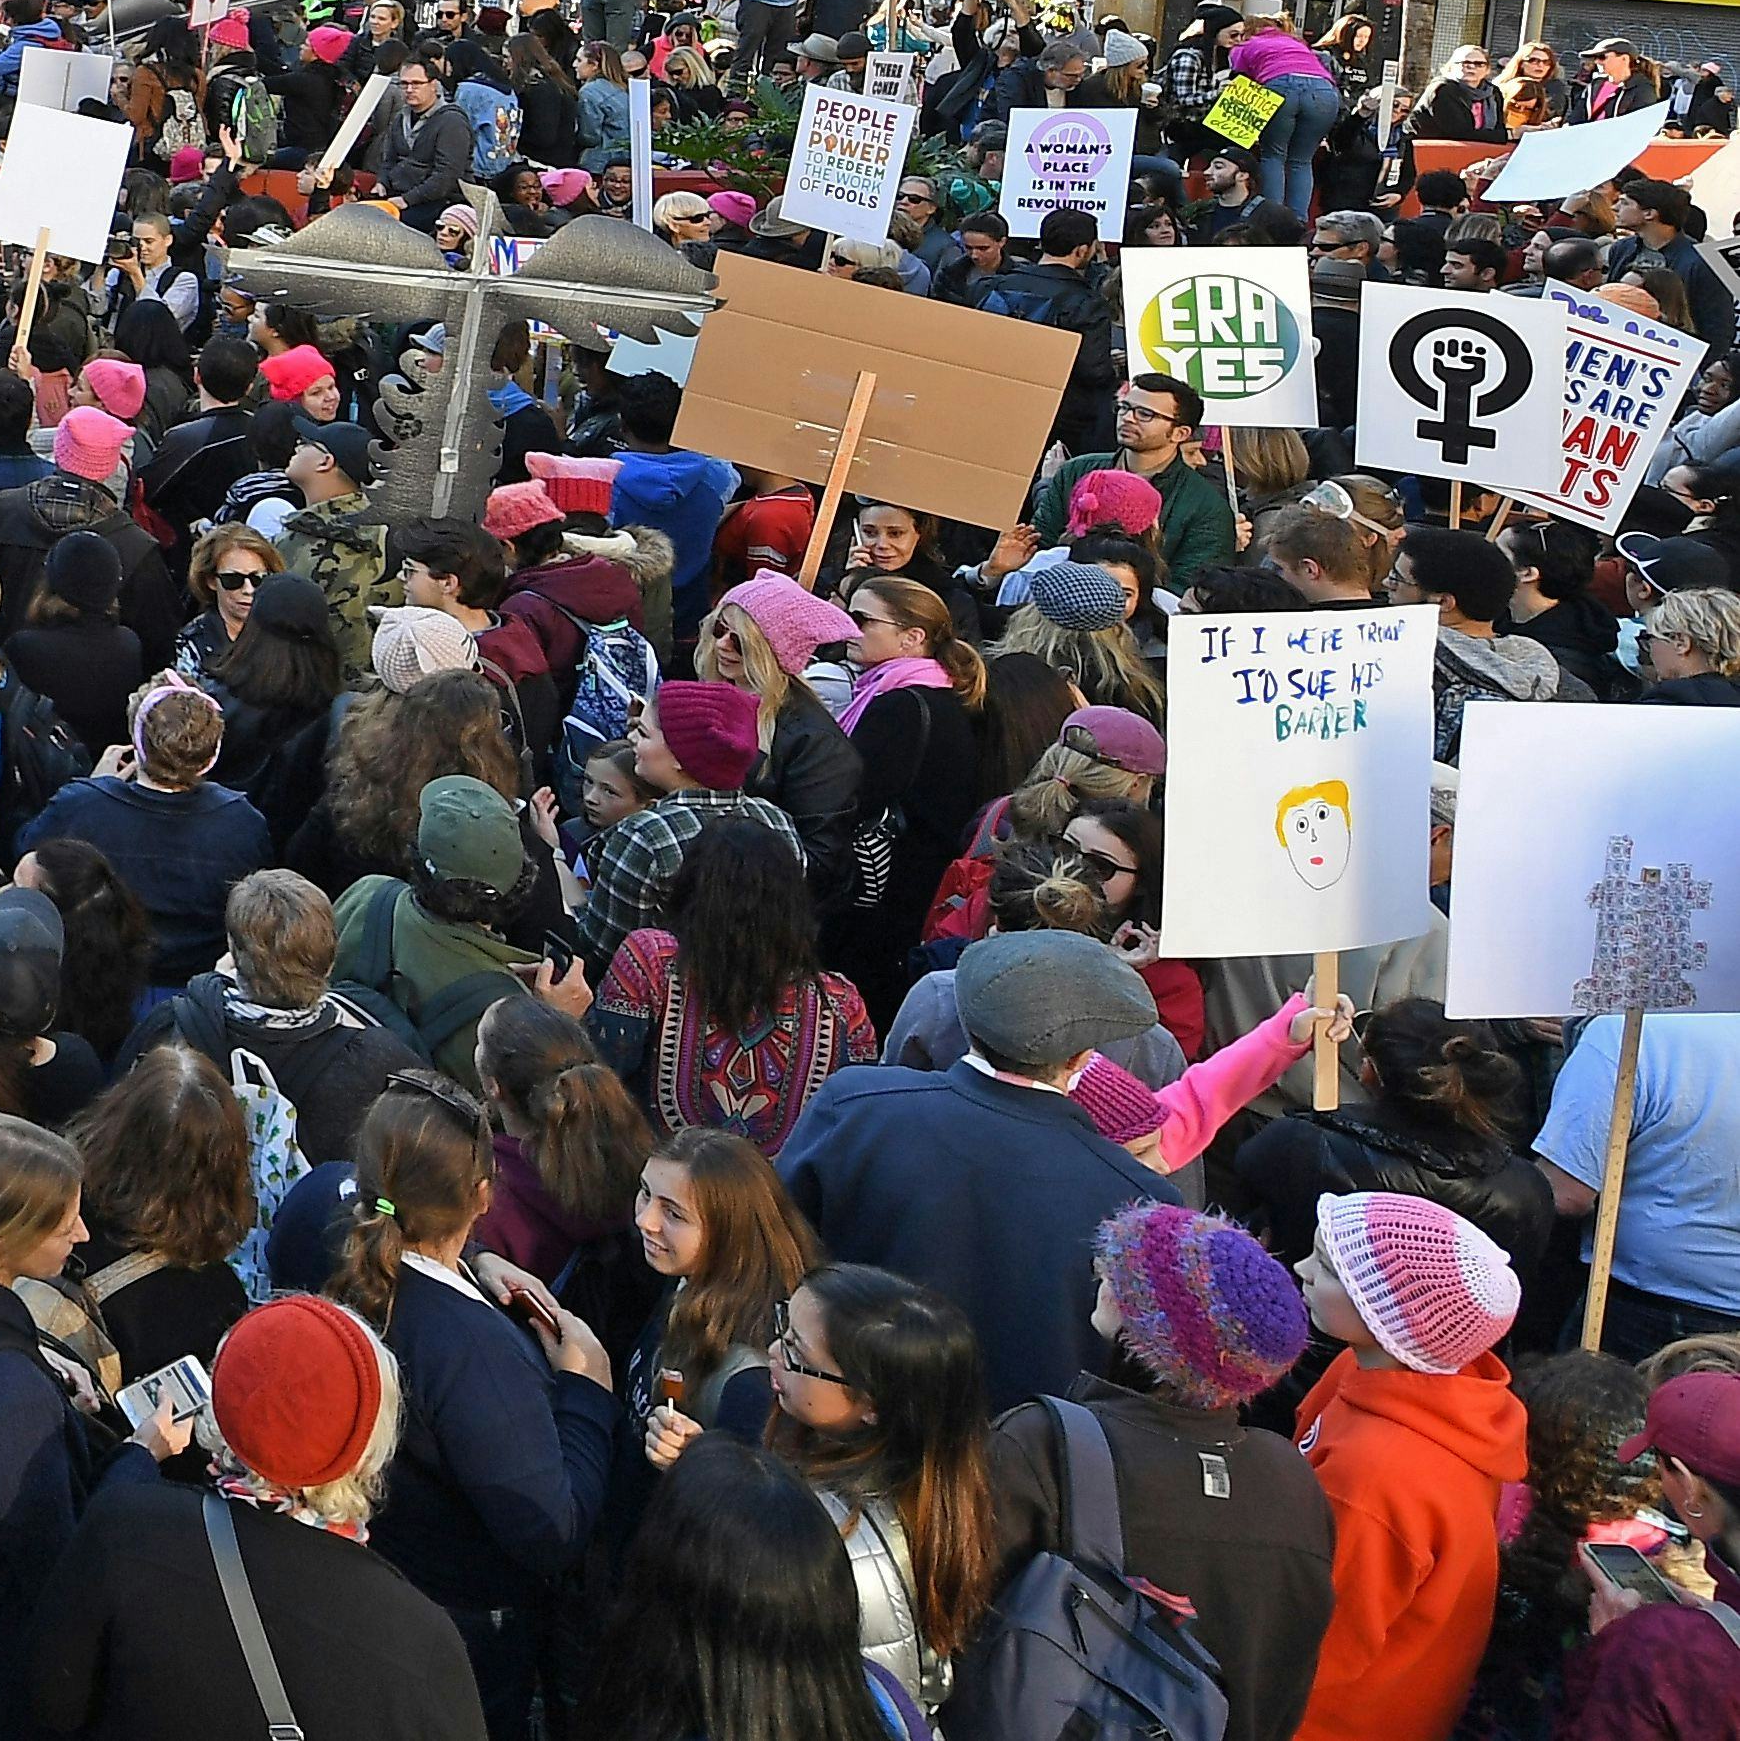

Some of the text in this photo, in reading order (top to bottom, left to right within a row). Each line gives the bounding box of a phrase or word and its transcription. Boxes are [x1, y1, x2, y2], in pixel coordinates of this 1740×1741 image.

[872, 80, 899, 96] COMES
[816, 98, 898, 131] PEOPLE
[812, 117, 893, 147] HAVE THE
[1025, 143, 1113, 155] A WOMAN'S
[804, 163, 882, 194] THE WORK
[806, 150, 885, 180] TO REDEEM
[1042, 162, 1090, 173] PLACE
[799, 177, 879, 209] OF FOOLS
[1032, 180, 1096, 192] IS IN THE
[1017, 198, 1107, 211] REVOLUTION
[1158, 275, 1278, 343] ERA
[1151, 346, 1284, 393] YES
[1589, 389, 1657, 429] ARE
[1200, 626, 1236, 663] IF
[1251, 626, 1267, 654] I
[1288, 668, 1337, 701] SUE
[1275, 699, 1368, 742] BARBER
